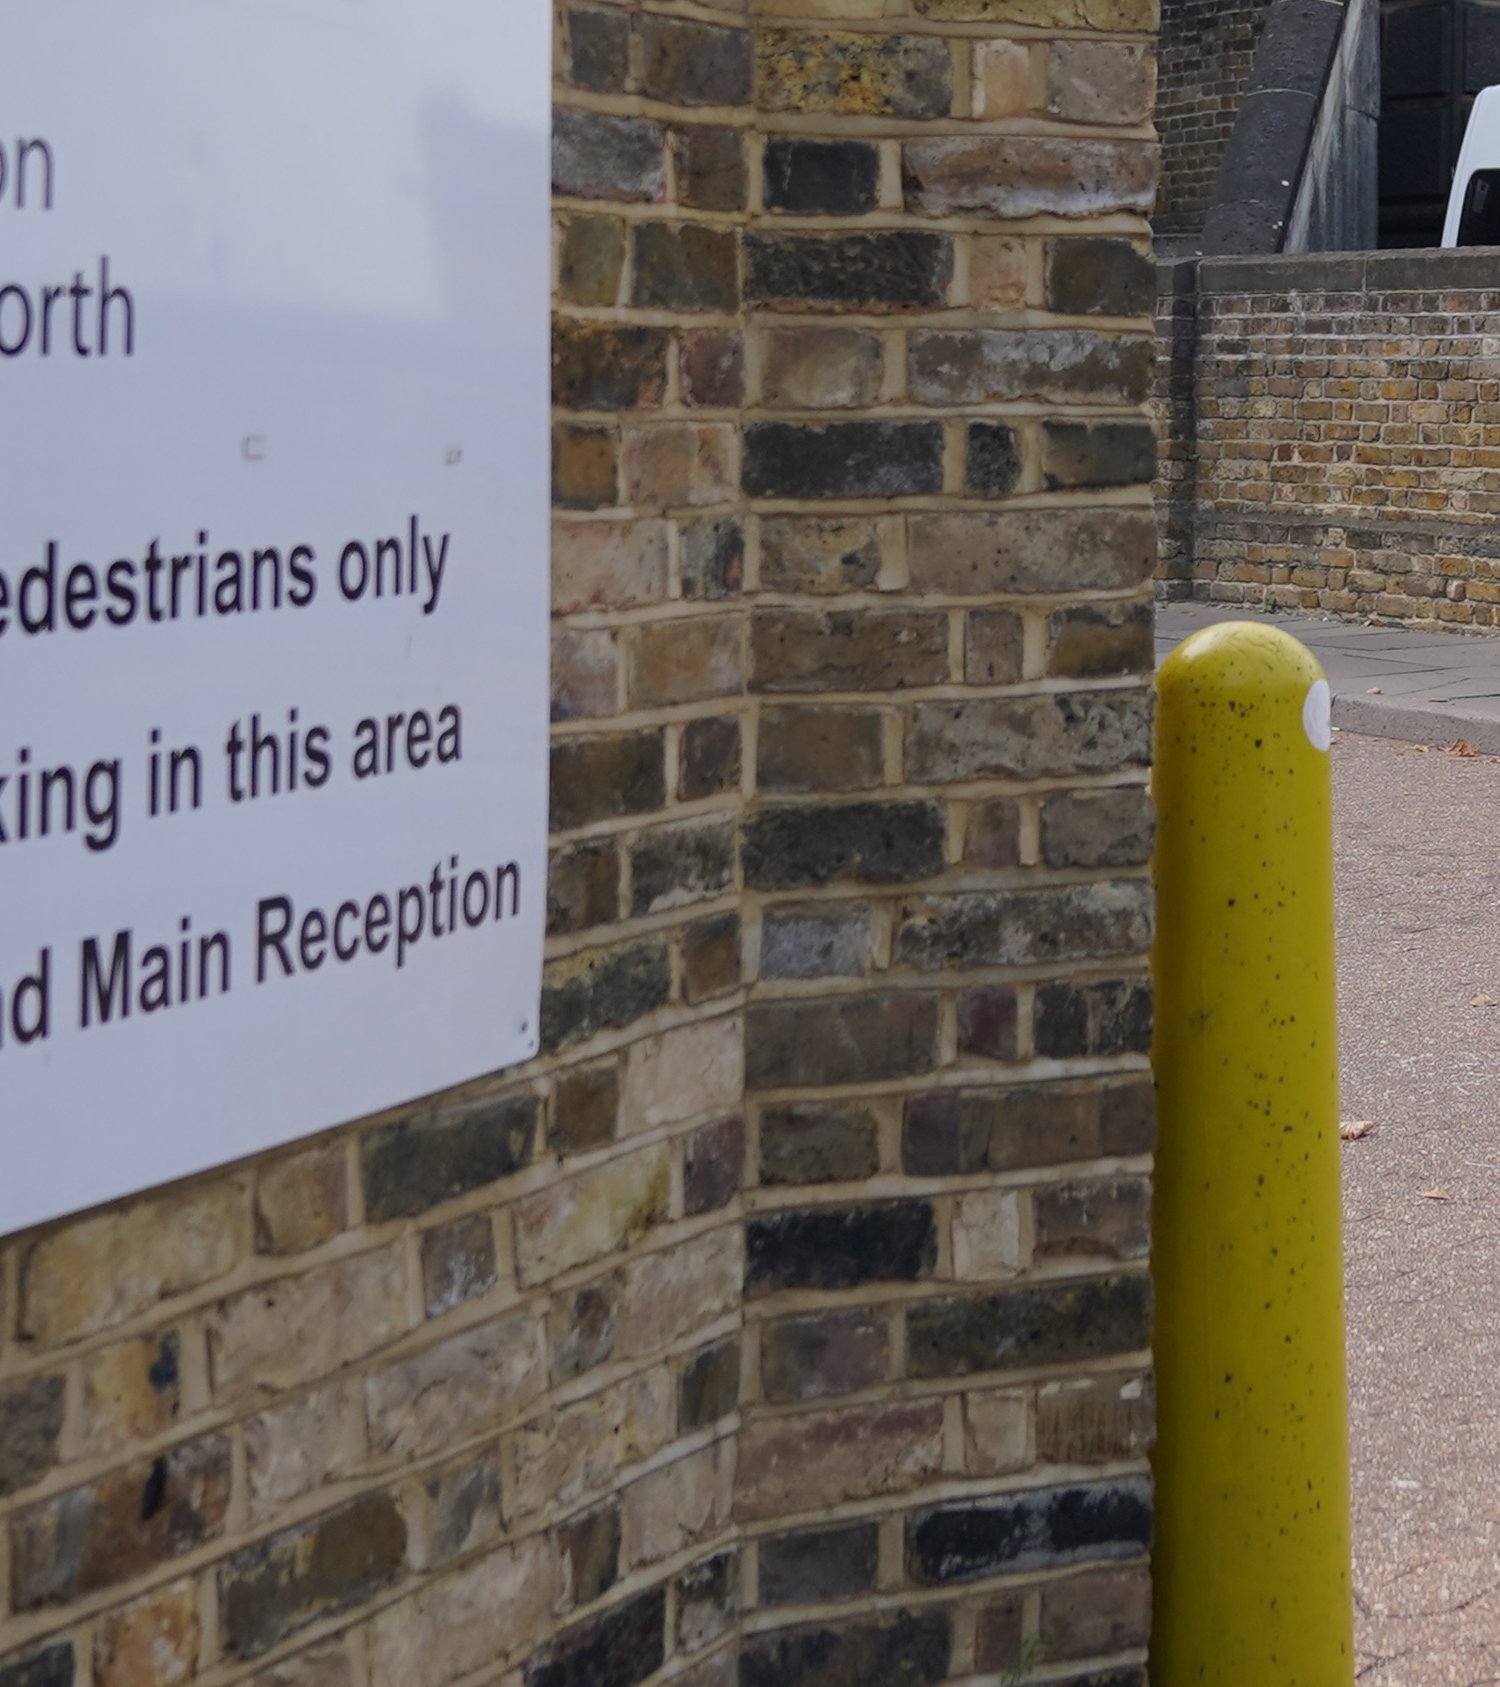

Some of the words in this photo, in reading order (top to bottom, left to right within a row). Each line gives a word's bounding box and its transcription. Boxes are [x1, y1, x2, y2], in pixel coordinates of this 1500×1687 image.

[338, 515, 450, 615] only
[149, 726, 202, 817] in
[225, 708, 332, 803] this
[353, 704, 462, 780] area
[79, 917, 230, 1029] Main
[256, 852, 520, 984] Reception
